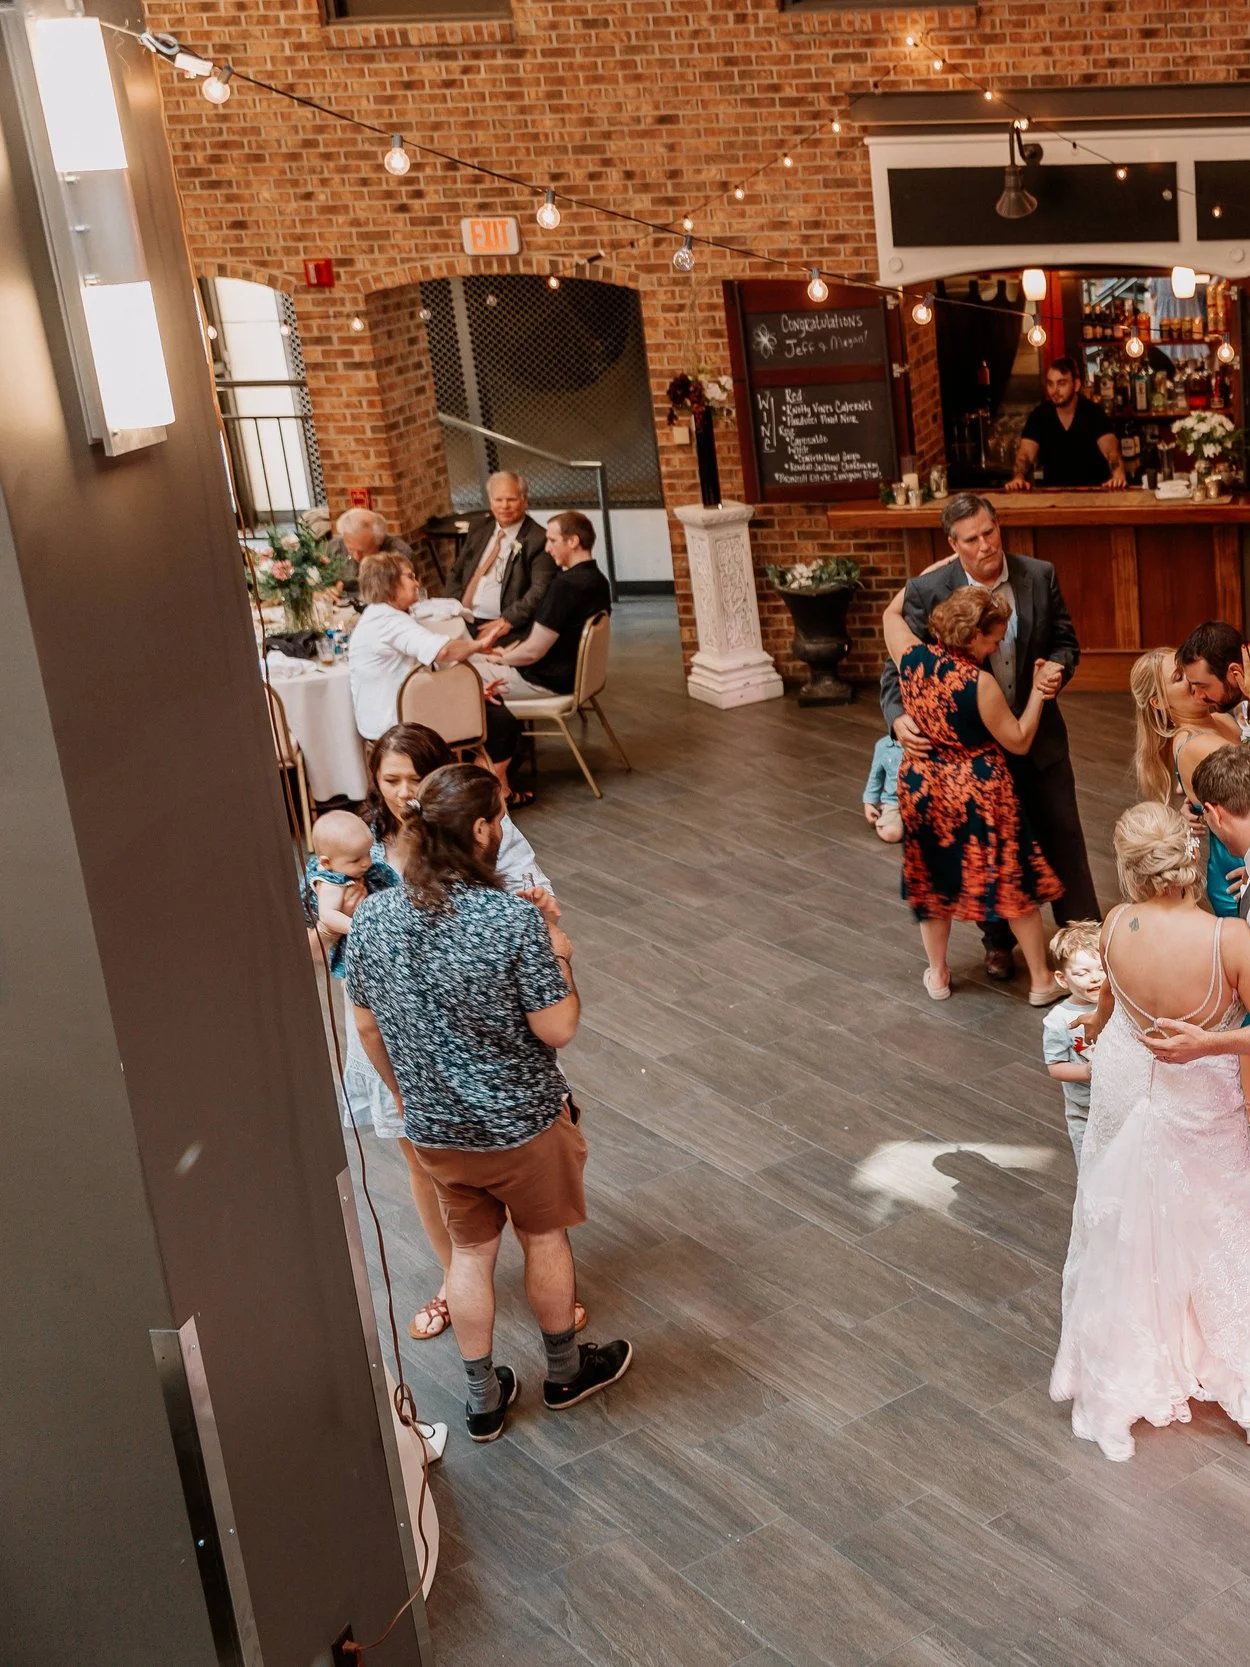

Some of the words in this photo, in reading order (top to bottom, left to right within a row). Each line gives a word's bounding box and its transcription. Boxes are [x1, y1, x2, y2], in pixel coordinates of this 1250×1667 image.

[470, 220, 510, 253] EXIT
[781, 313, 863, 338] Congratulations
[785, 339, 815, 358] Jeff
[785, 388, 802, 403] Red
